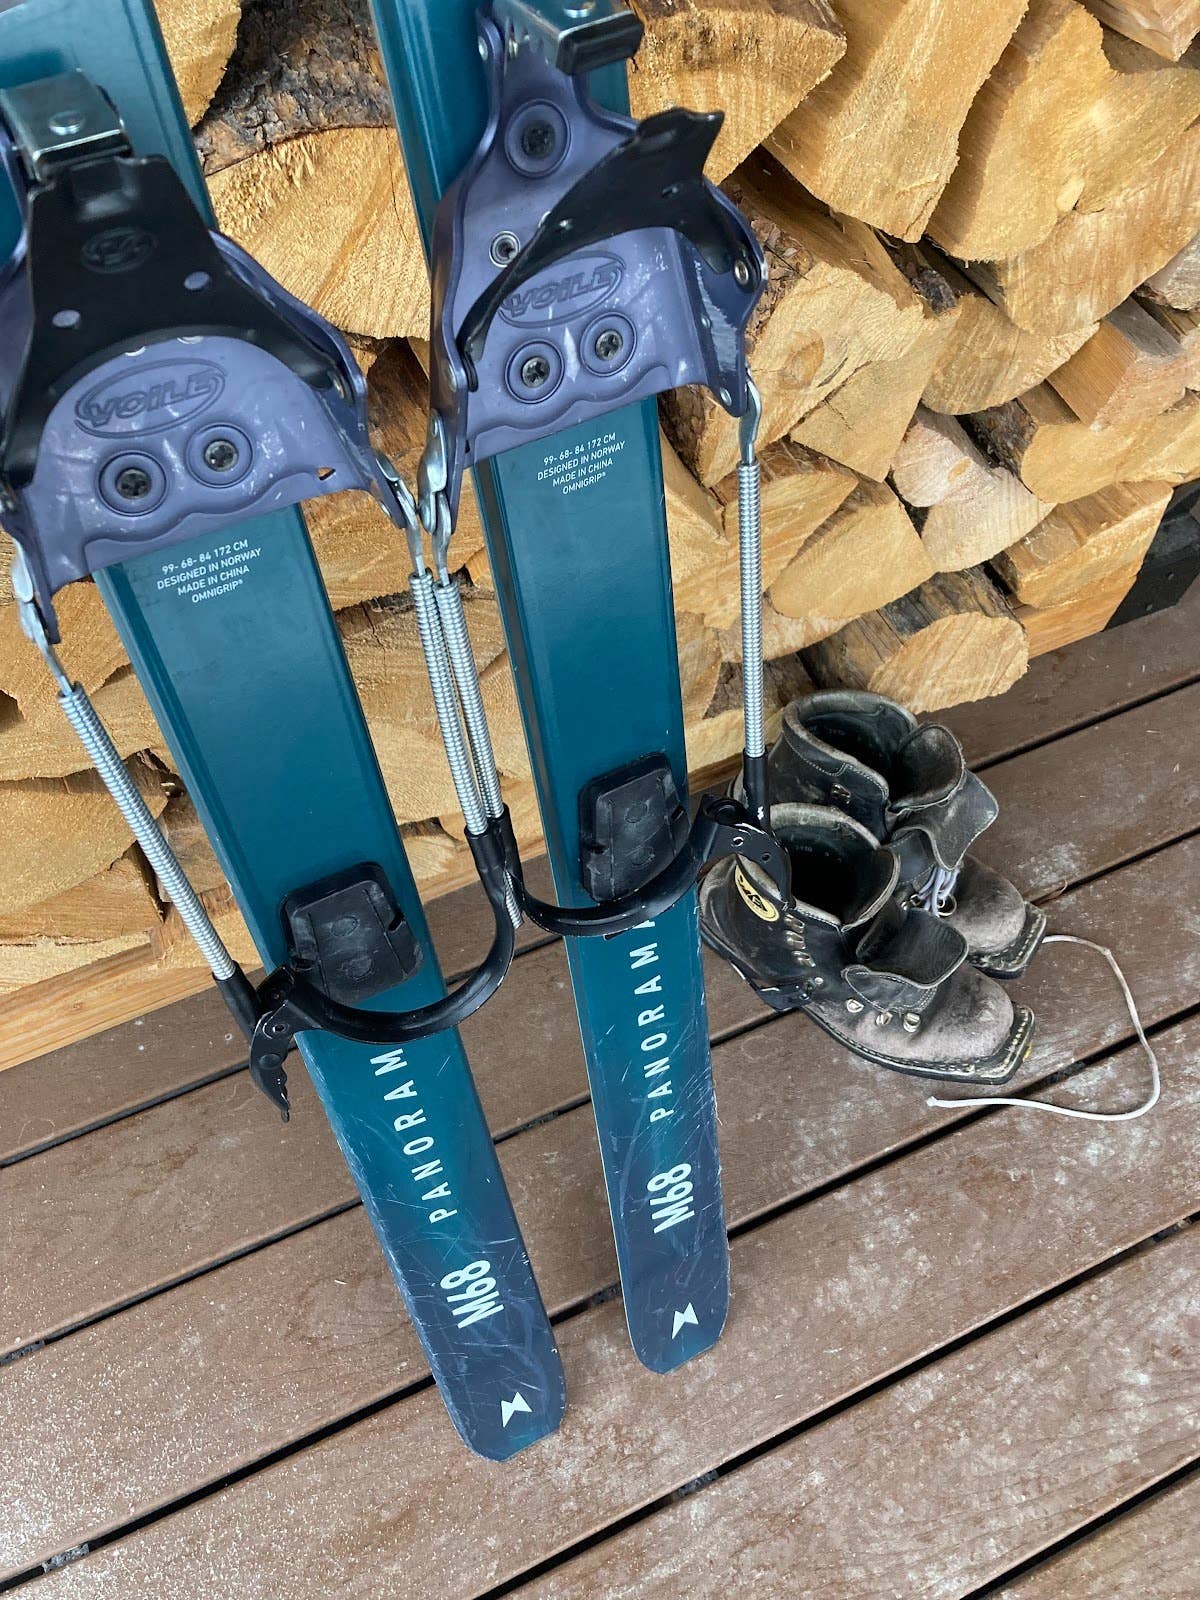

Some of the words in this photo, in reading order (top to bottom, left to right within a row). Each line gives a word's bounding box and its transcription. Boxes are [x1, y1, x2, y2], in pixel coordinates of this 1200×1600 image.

[83, 368, 215, 428] VOILE
[537, 458, 579, 481] DESIGNED
[580, 454, 589, 465] IN
[590, 440, 626, 461] NORWAY
[552, 470, 576, 488] MADE
[577, 467, 587, 478] IN
[588, 457, 613, 474] CHINA
[156, 565, 207, 590] DESIGNED
[208, 561, 219, 573] IN
[220, 547, 262, 569] NORWAY
[177, 578, 207, 596] MADE
[207, 575, 218, 586] IN
[219, 564, 250, 581] CHINA
[646, 1163, 695, 1234] M68
[440, 1260, 504, 1329] M68
